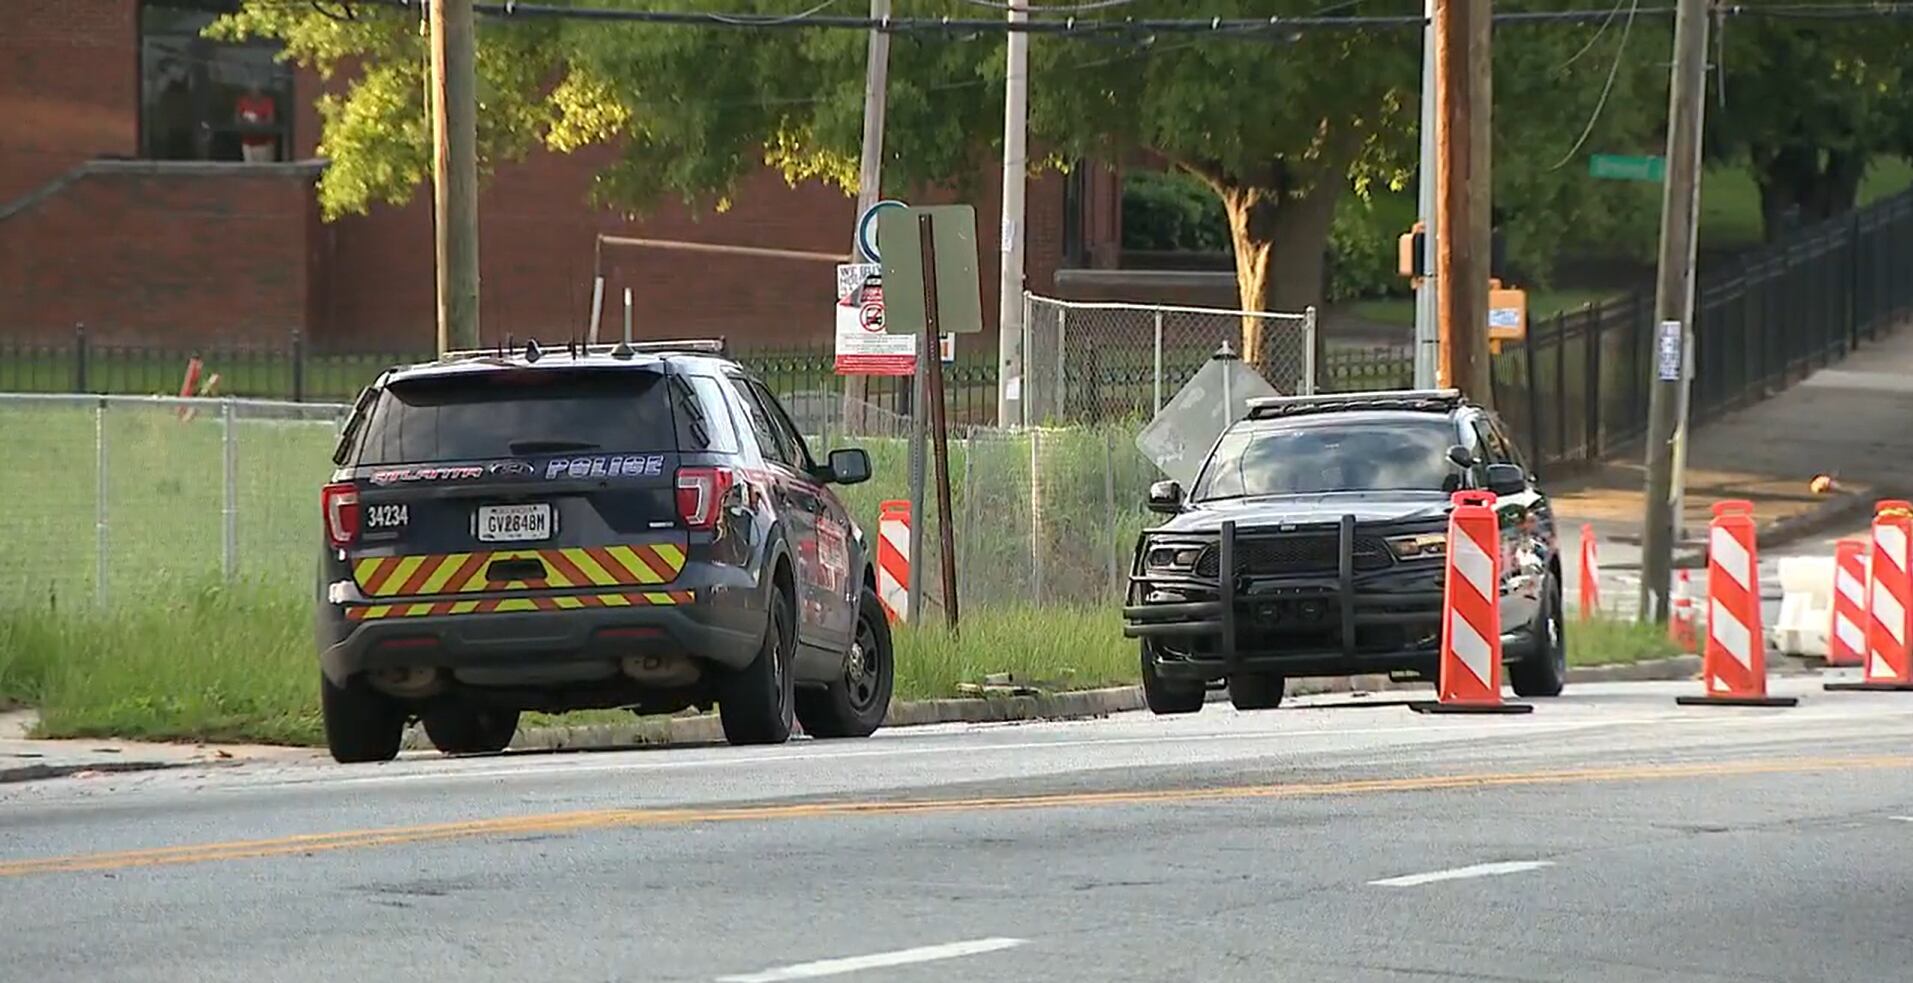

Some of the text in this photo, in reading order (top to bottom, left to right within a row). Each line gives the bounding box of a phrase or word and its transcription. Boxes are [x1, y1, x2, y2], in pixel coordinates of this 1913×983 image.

[370, 465, 484, 485] ATLANTA
[545, 455, 664, 479] POLICE
[367, 504, 409, 527] 34234
